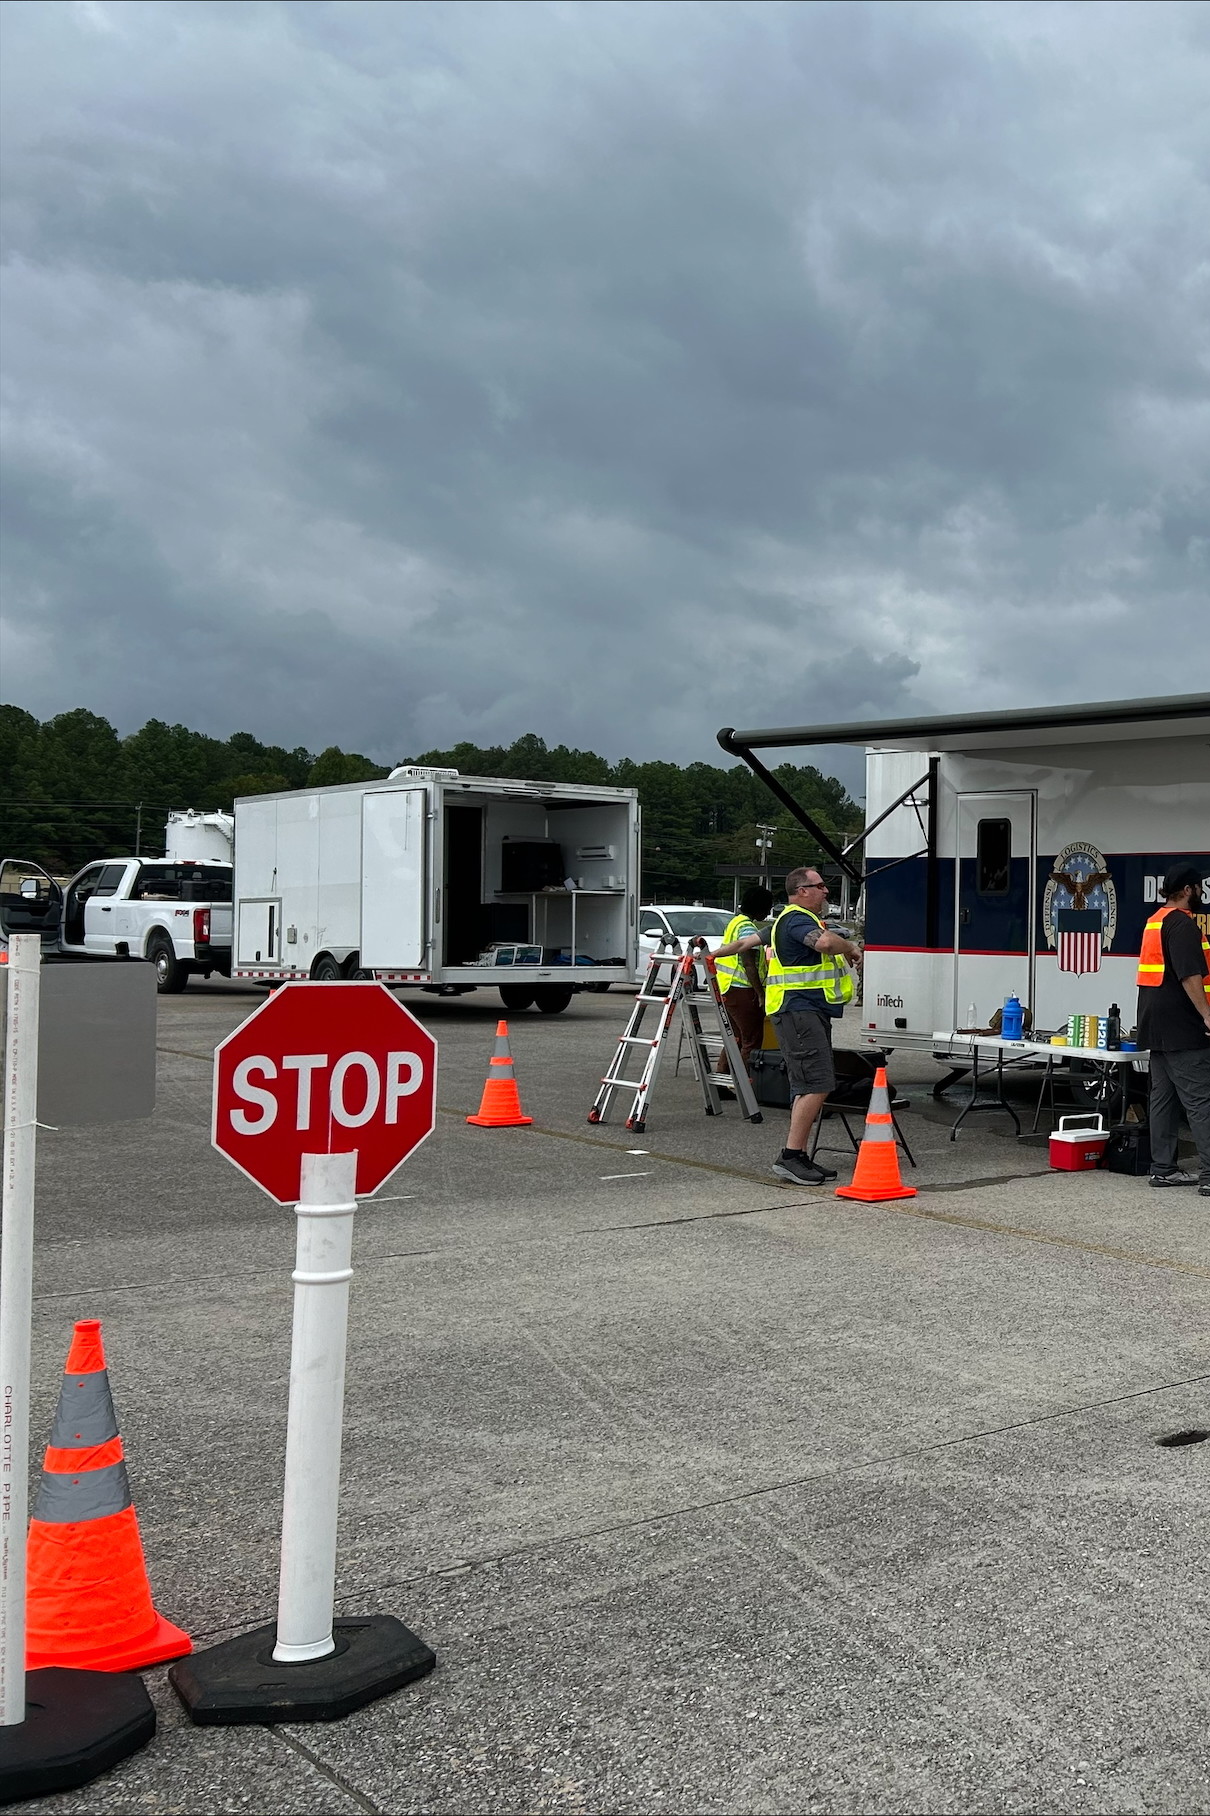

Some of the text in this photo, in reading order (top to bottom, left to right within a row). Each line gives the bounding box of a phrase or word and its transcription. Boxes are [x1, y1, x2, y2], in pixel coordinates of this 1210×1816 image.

[1060, 843, 1099, 860] LOGISTICS
[877, 994, 904, 1008] inTech
[229, 1051, 424, 1136] STOP
[3, 1385, 13, 1472] CHARLOTTE
[2, 1483, 11, 1521] PIPE
